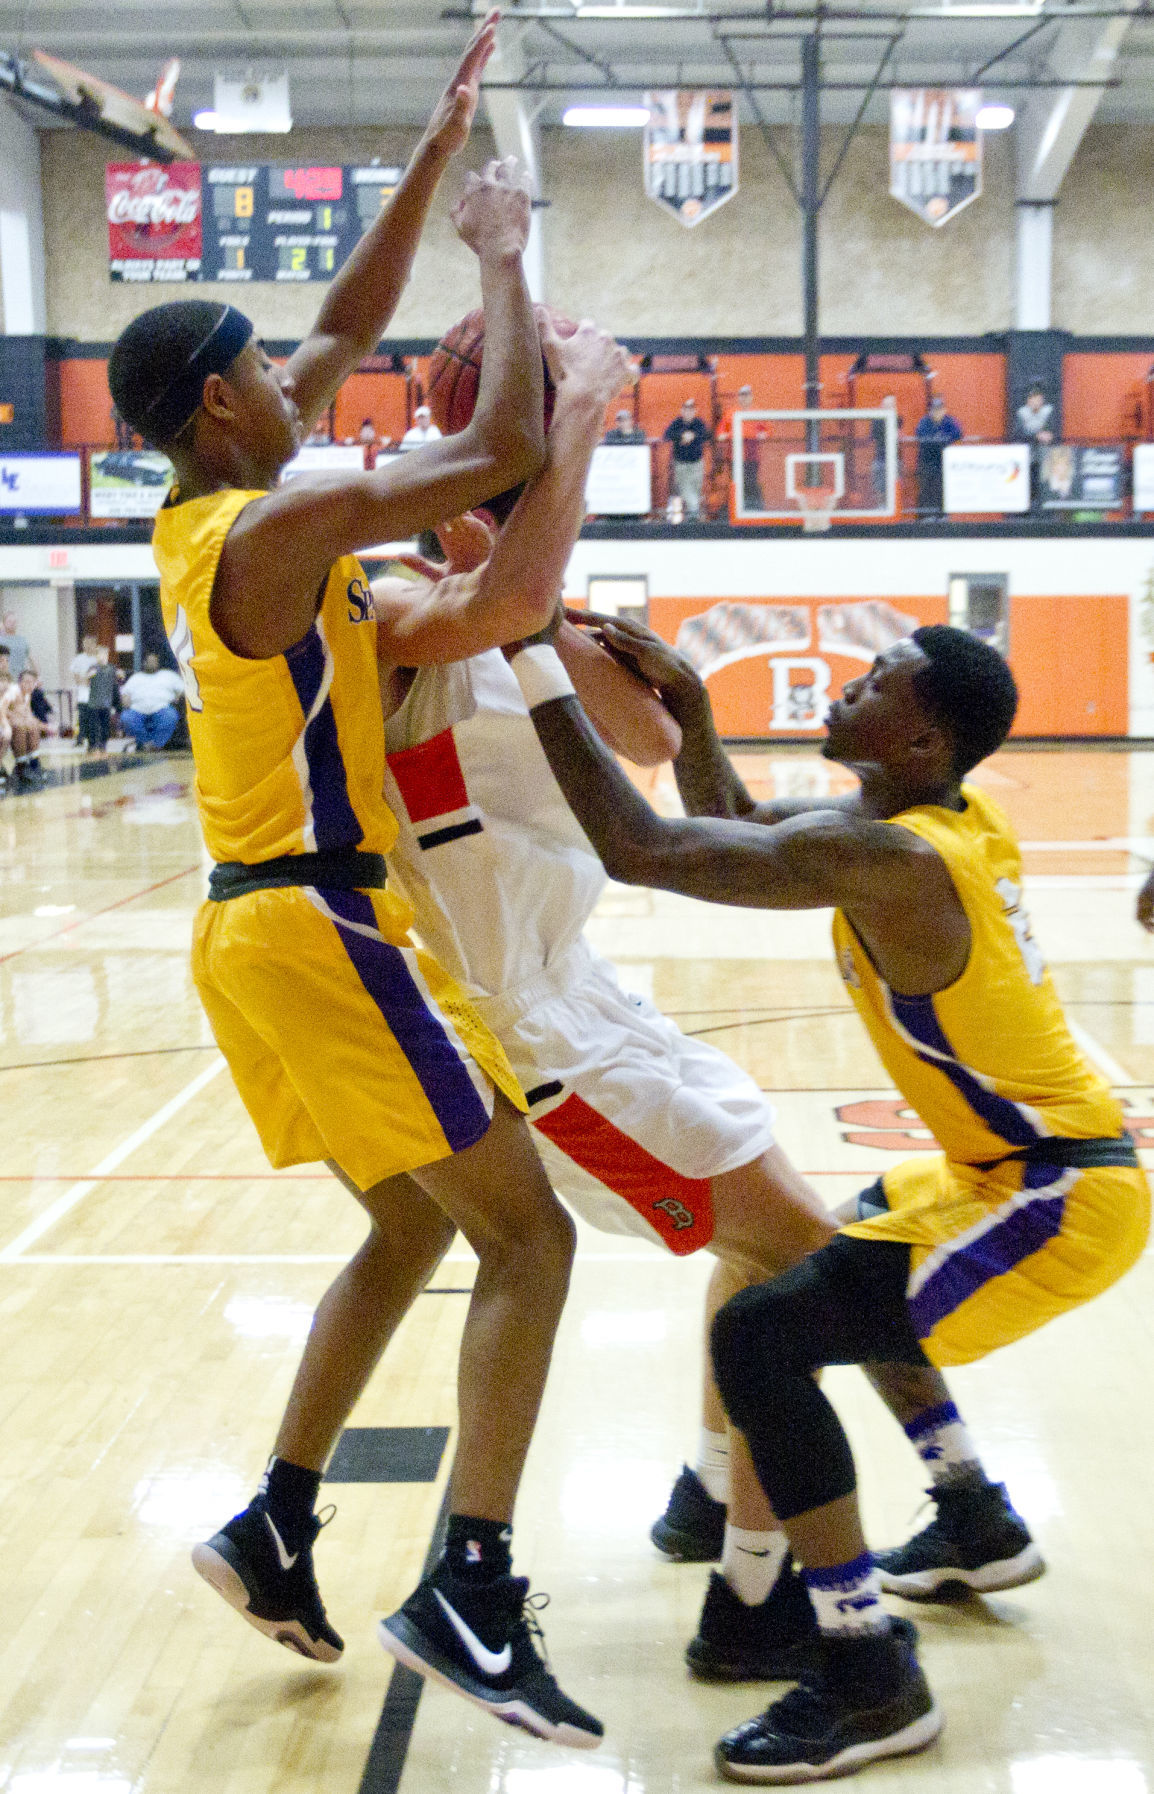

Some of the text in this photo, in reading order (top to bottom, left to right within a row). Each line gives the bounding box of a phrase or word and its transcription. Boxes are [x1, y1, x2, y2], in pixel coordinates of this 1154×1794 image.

[234, 187, 254, 218] 8
[291, 248, 307, 272] 2
[768, 657, 833, 730] B
[652, 1197, 695, 1231] B
